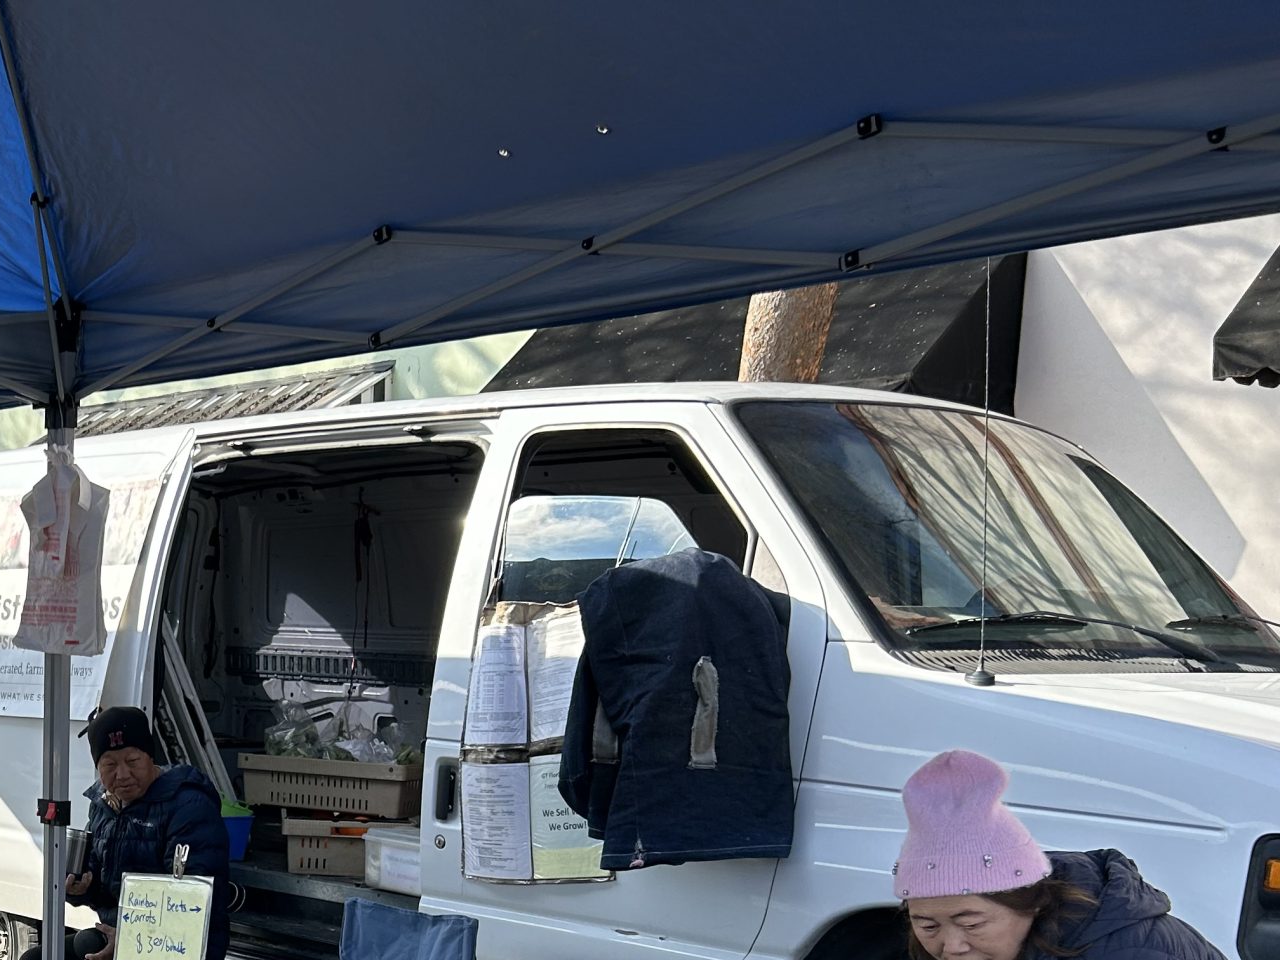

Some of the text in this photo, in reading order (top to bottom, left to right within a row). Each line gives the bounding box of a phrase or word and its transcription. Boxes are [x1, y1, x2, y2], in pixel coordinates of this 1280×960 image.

[71, 664, 93, 680] lways
[1, 691, 20, 701] WHAT
[24, 693, 34, 701] WE
[542, 809, 554, 817] We
[556, 808, 569, 816] Sell
[549, 821, 587, 831] We Grow!
[128, 891, 157, 908] Rainbow
[166, 896, 186, 912] Beets
[130, 910, 156, 924] Carrots
